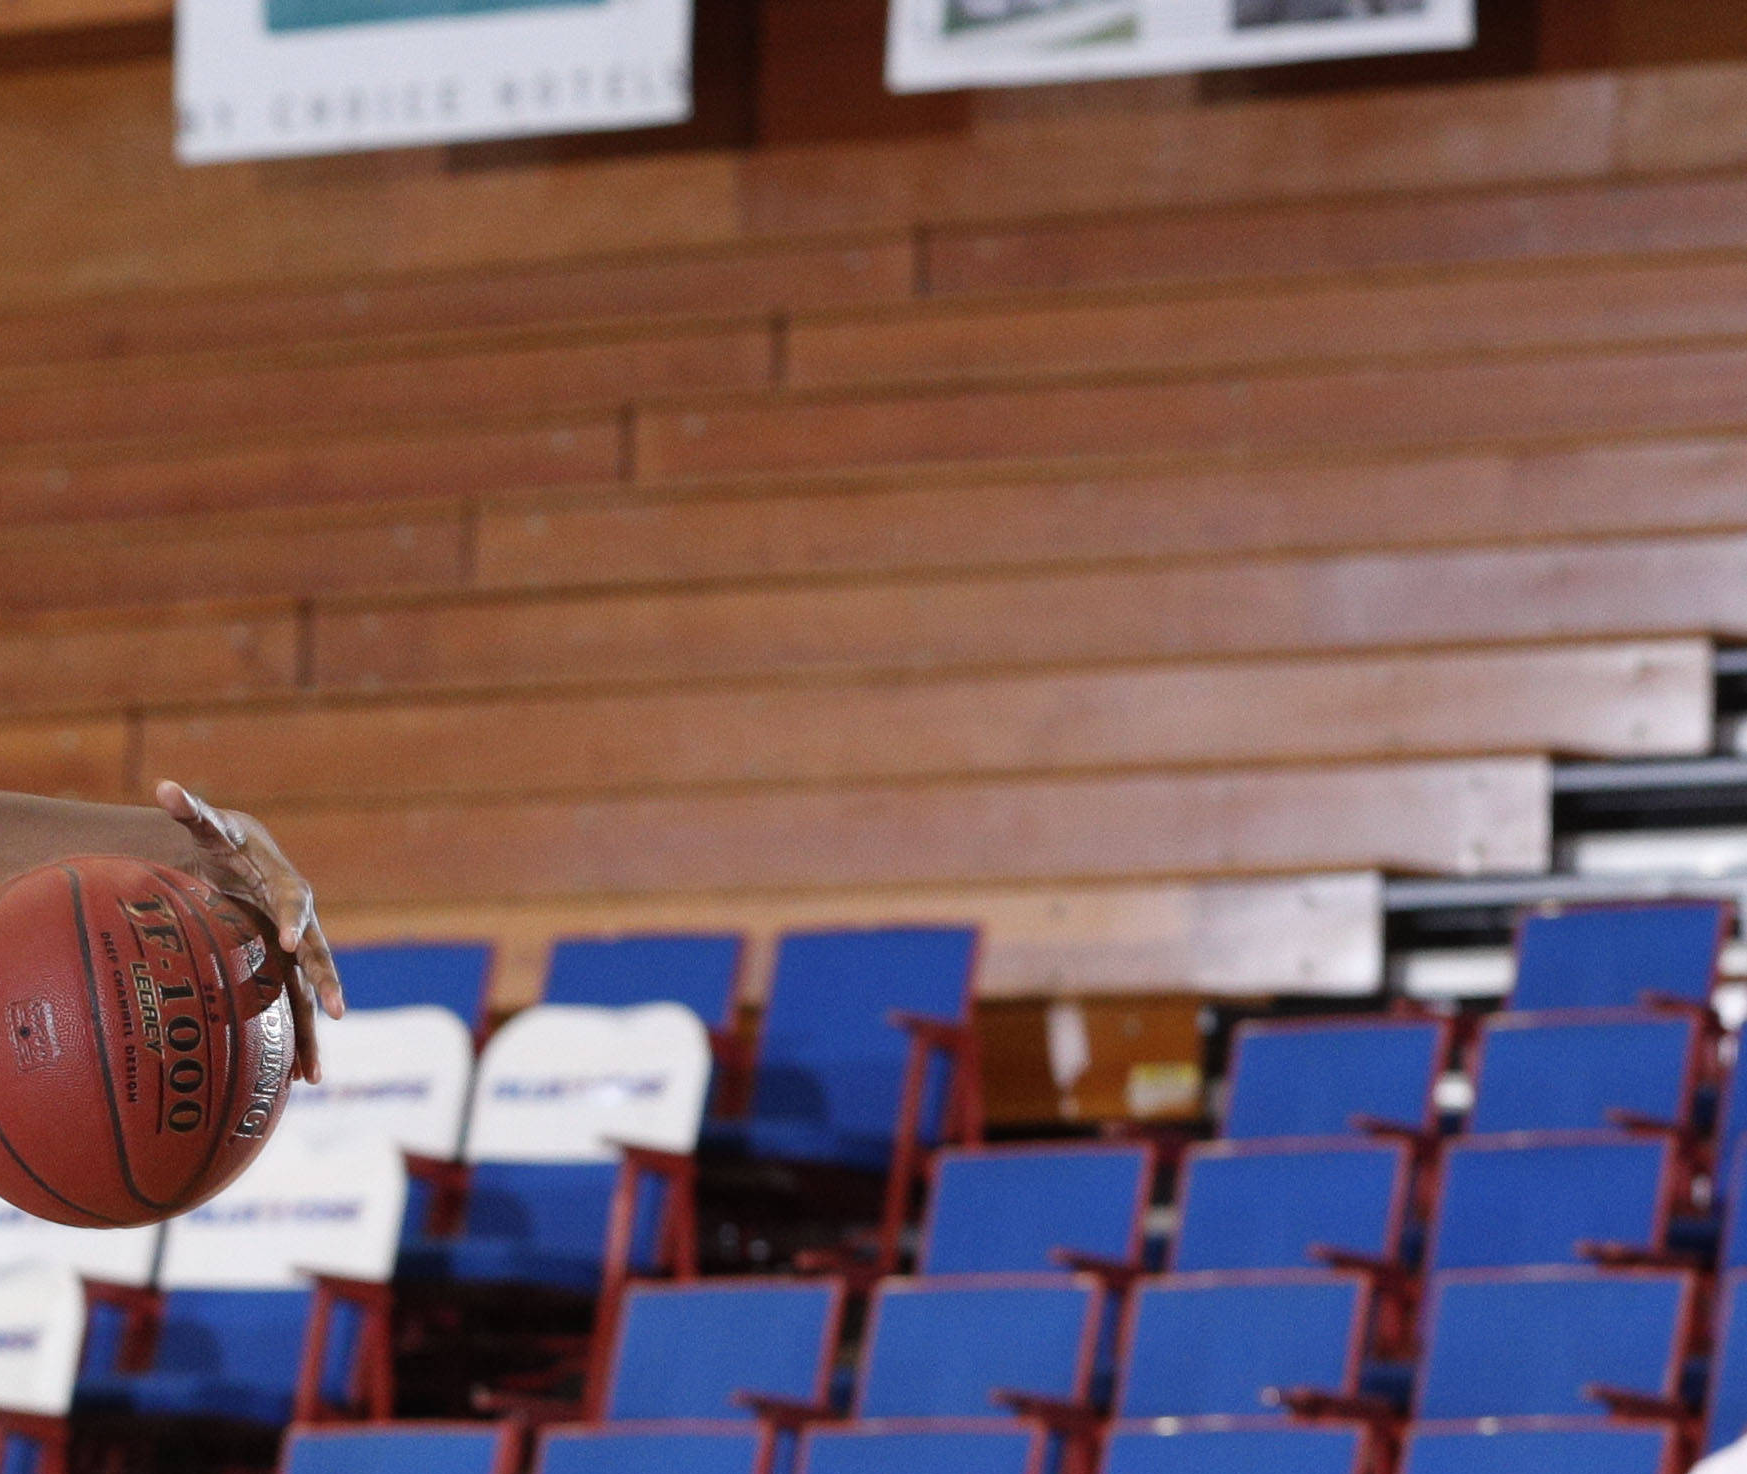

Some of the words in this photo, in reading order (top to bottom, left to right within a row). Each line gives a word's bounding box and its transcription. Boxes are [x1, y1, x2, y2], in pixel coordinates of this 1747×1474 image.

[101, 931, 119, 962] DEEP
[114, 969, 134, 1037] CHANNEL
[125, 1045, 138, 1103] DESIGN
[124, 893, 205, 1134] TF-1000
[130, 961, 166, 1060] LEGACY
